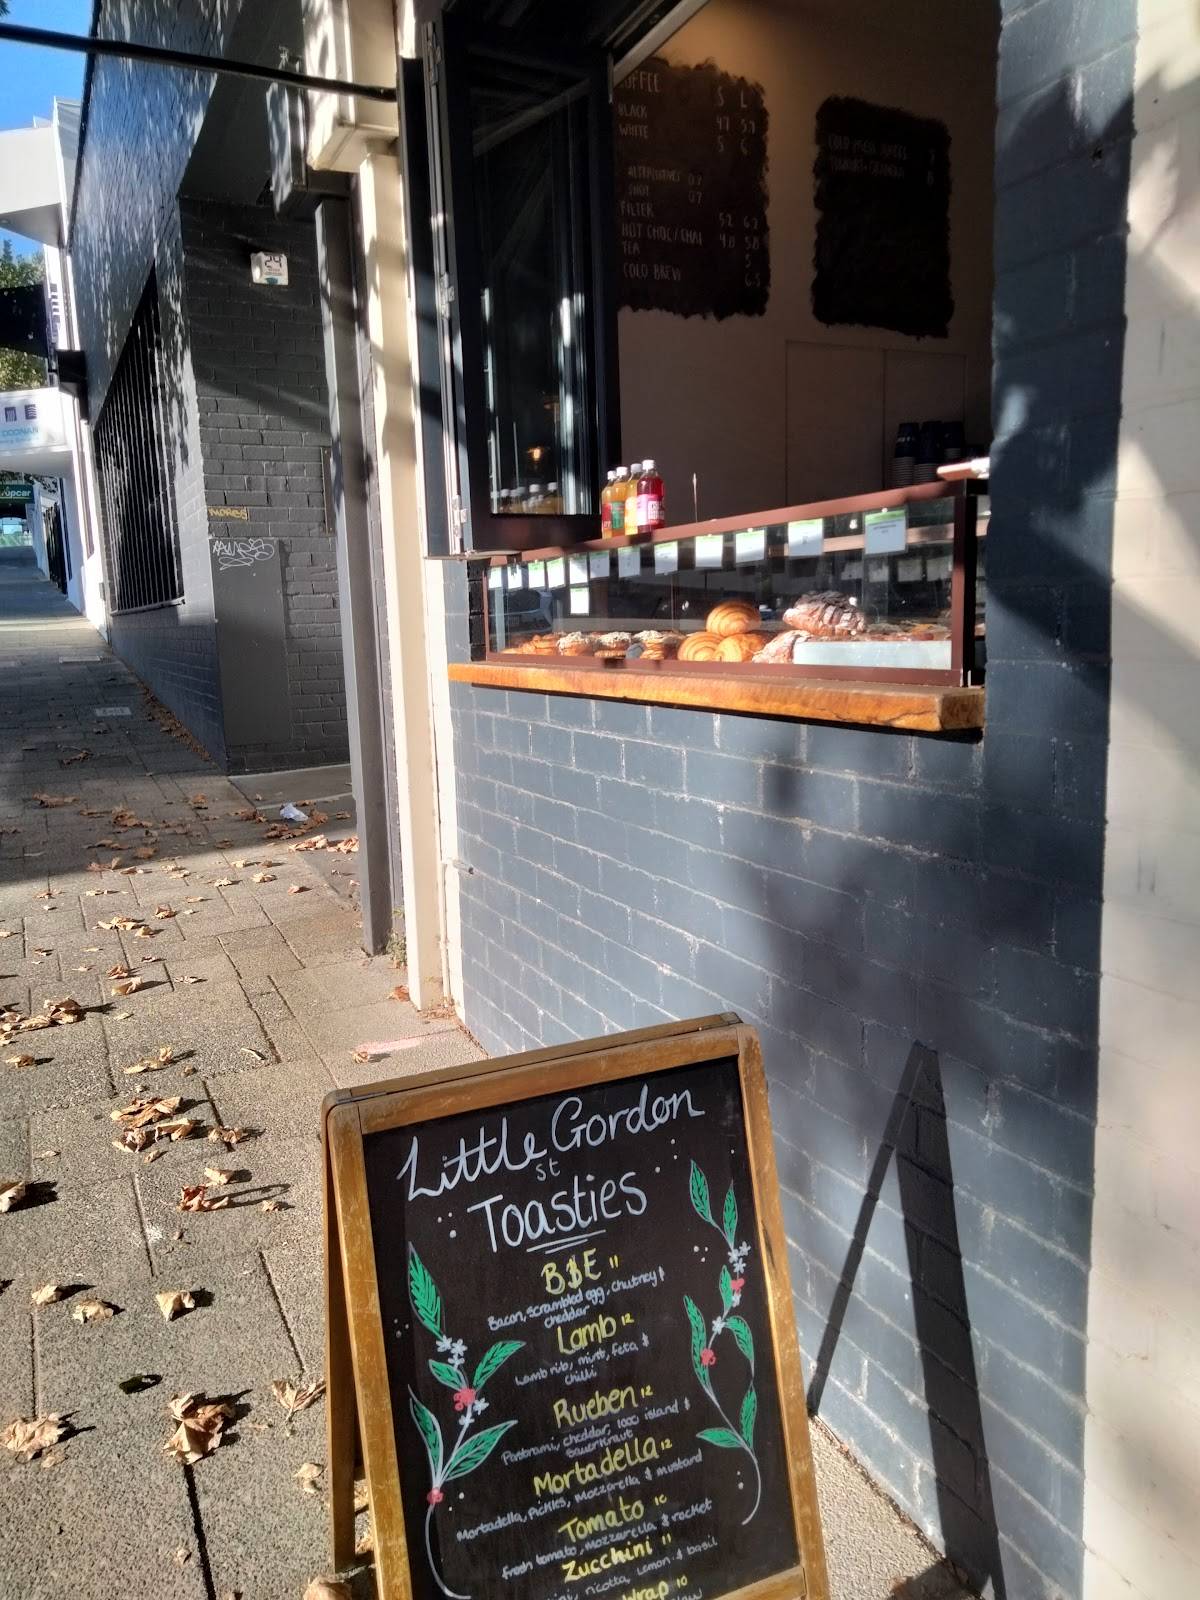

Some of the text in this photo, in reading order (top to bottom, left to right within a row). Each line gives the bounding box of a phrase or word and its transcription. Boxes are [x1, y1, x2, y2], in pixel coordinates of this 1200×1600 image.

[620, 200, 655, 218] FILTER
[621, 222, 644, 238] HOT
[621, 240, 641, 255] TEA
[623, 262, 649, 279] COLD
[653, 264, 682, 282] BREW
[396, 1083, 706, 1202] Little Gordon
[467, 1171, 648, 1254] Toasties
[526, 1288, 584, 1318] scrambled
[544, 1305, 591, 1329] cheddar
[557, 1313, 635, 1355] Lamb 12
[553, 1384, 654, 1429] Rueben 12
[644, 1398, 680, 1421] island
[533, 1436, 673, 1497] Mortadella 12
[656, 1448, 703, 1477] mustard
[558, 1495, 645, 1543] Tomato
[671, 1497, 713, 1521] rocket
[562, 1535, 653, 1584] Zucchini
[686, 1534, 719, 1556] basil
